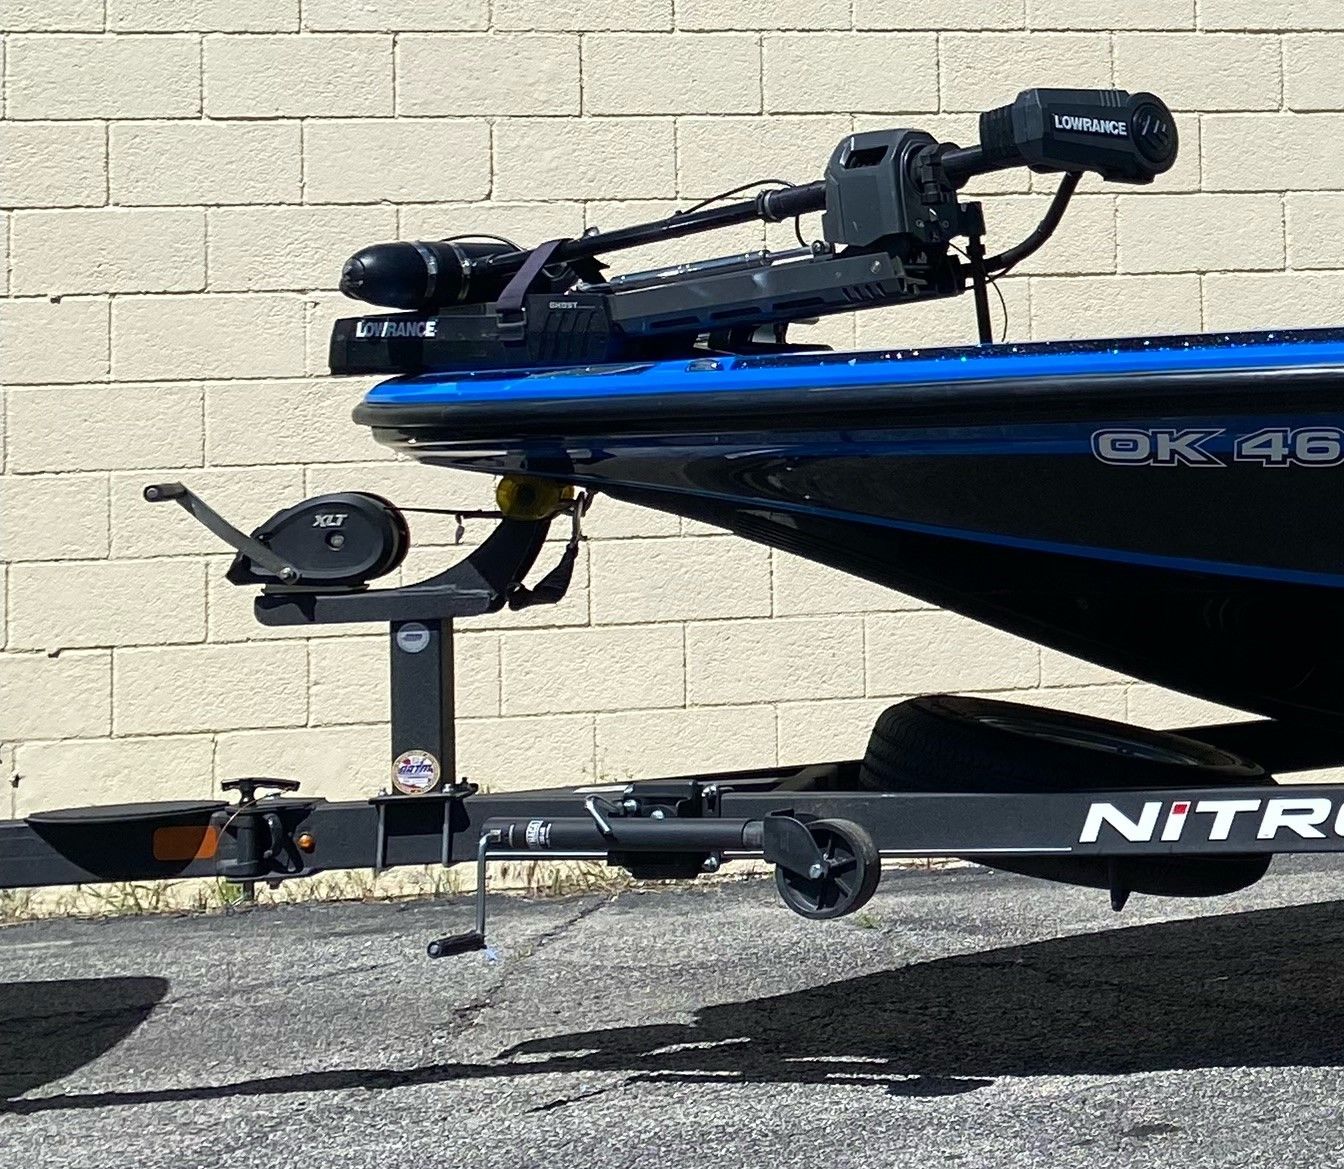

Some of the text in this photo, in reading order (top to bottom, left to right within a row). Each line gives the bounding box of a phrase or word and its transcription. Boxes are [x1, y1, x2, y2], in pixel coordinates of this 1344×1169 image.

[1053, 114, 1127, 136] LOWRANCE
[355, 320, 437, 338] LOWRANCE
[1091, 428, 1227, 468] OK
[312, 513, 349, 528] XLT
